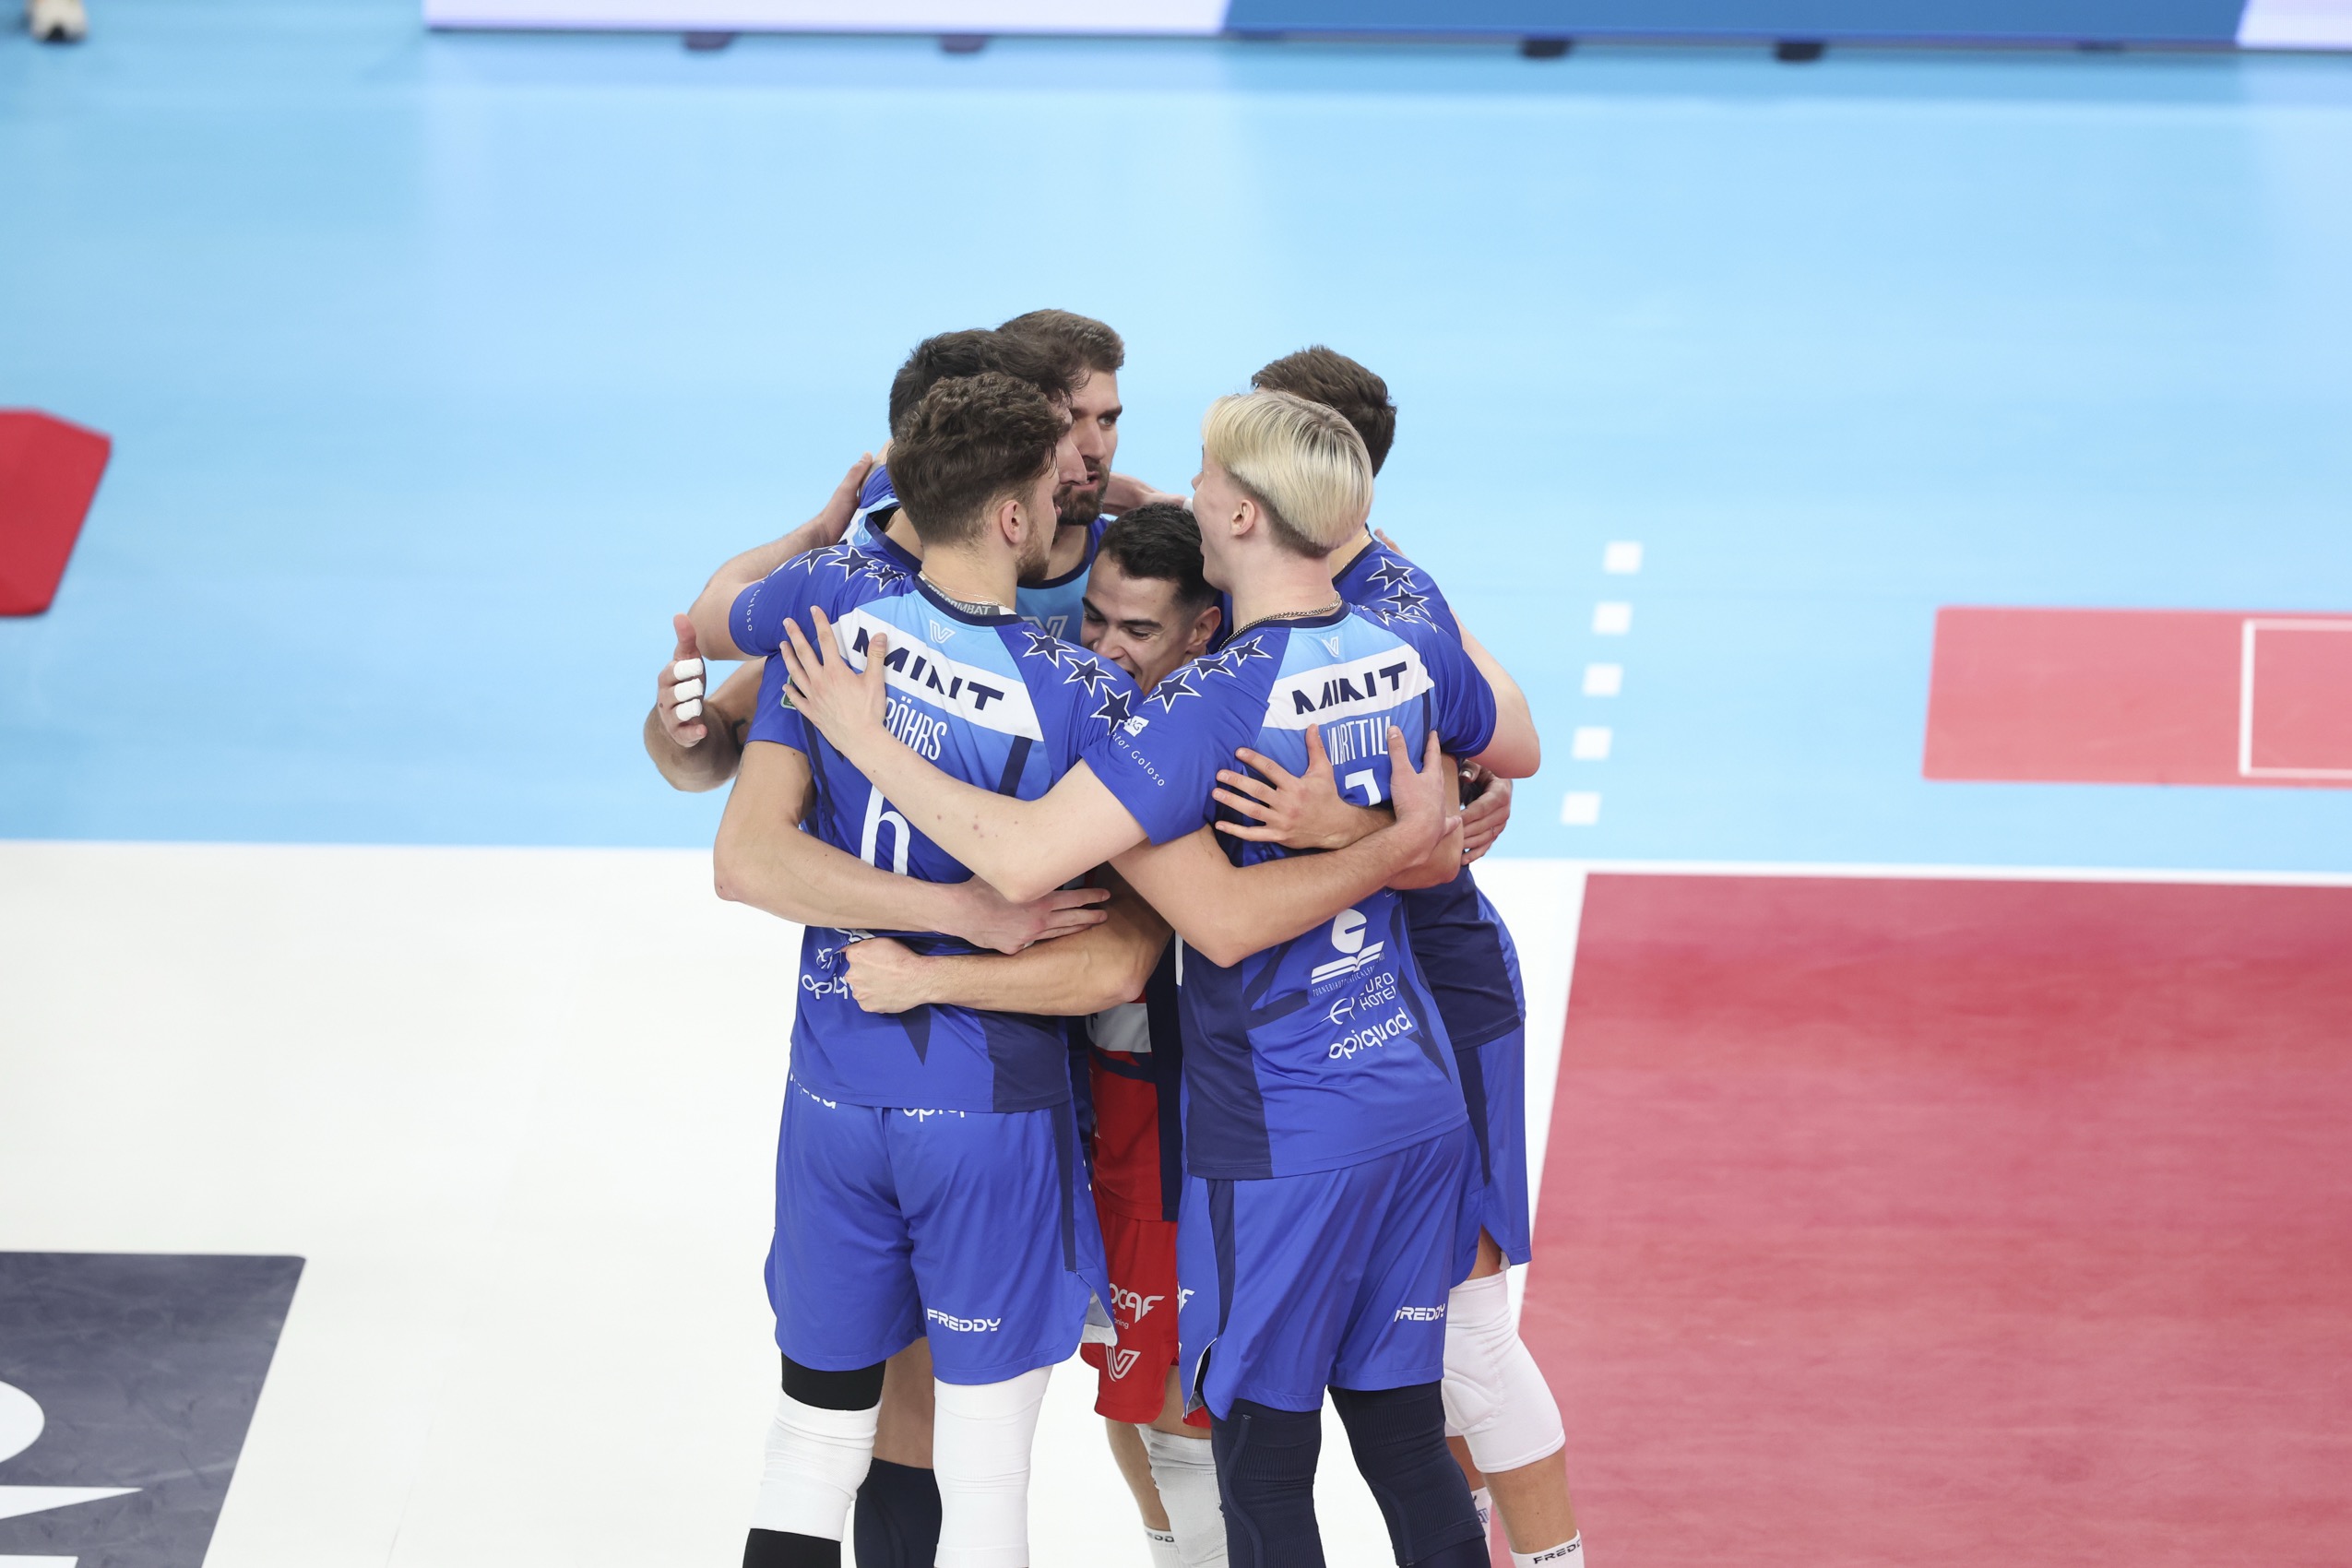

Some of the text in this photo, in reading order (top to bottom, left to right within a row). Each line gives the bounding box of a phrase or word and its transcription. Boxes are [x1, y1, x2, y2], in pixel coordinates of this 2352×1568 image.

[852, 626, 1005, 711] MINT
[1291, 660, 1408, 716] MINT
[1131, 750, 1165, 787] Goloso
[1360, 972, 1395, 996] URO
[927, 1307, 1002, 1333] FREDDY
